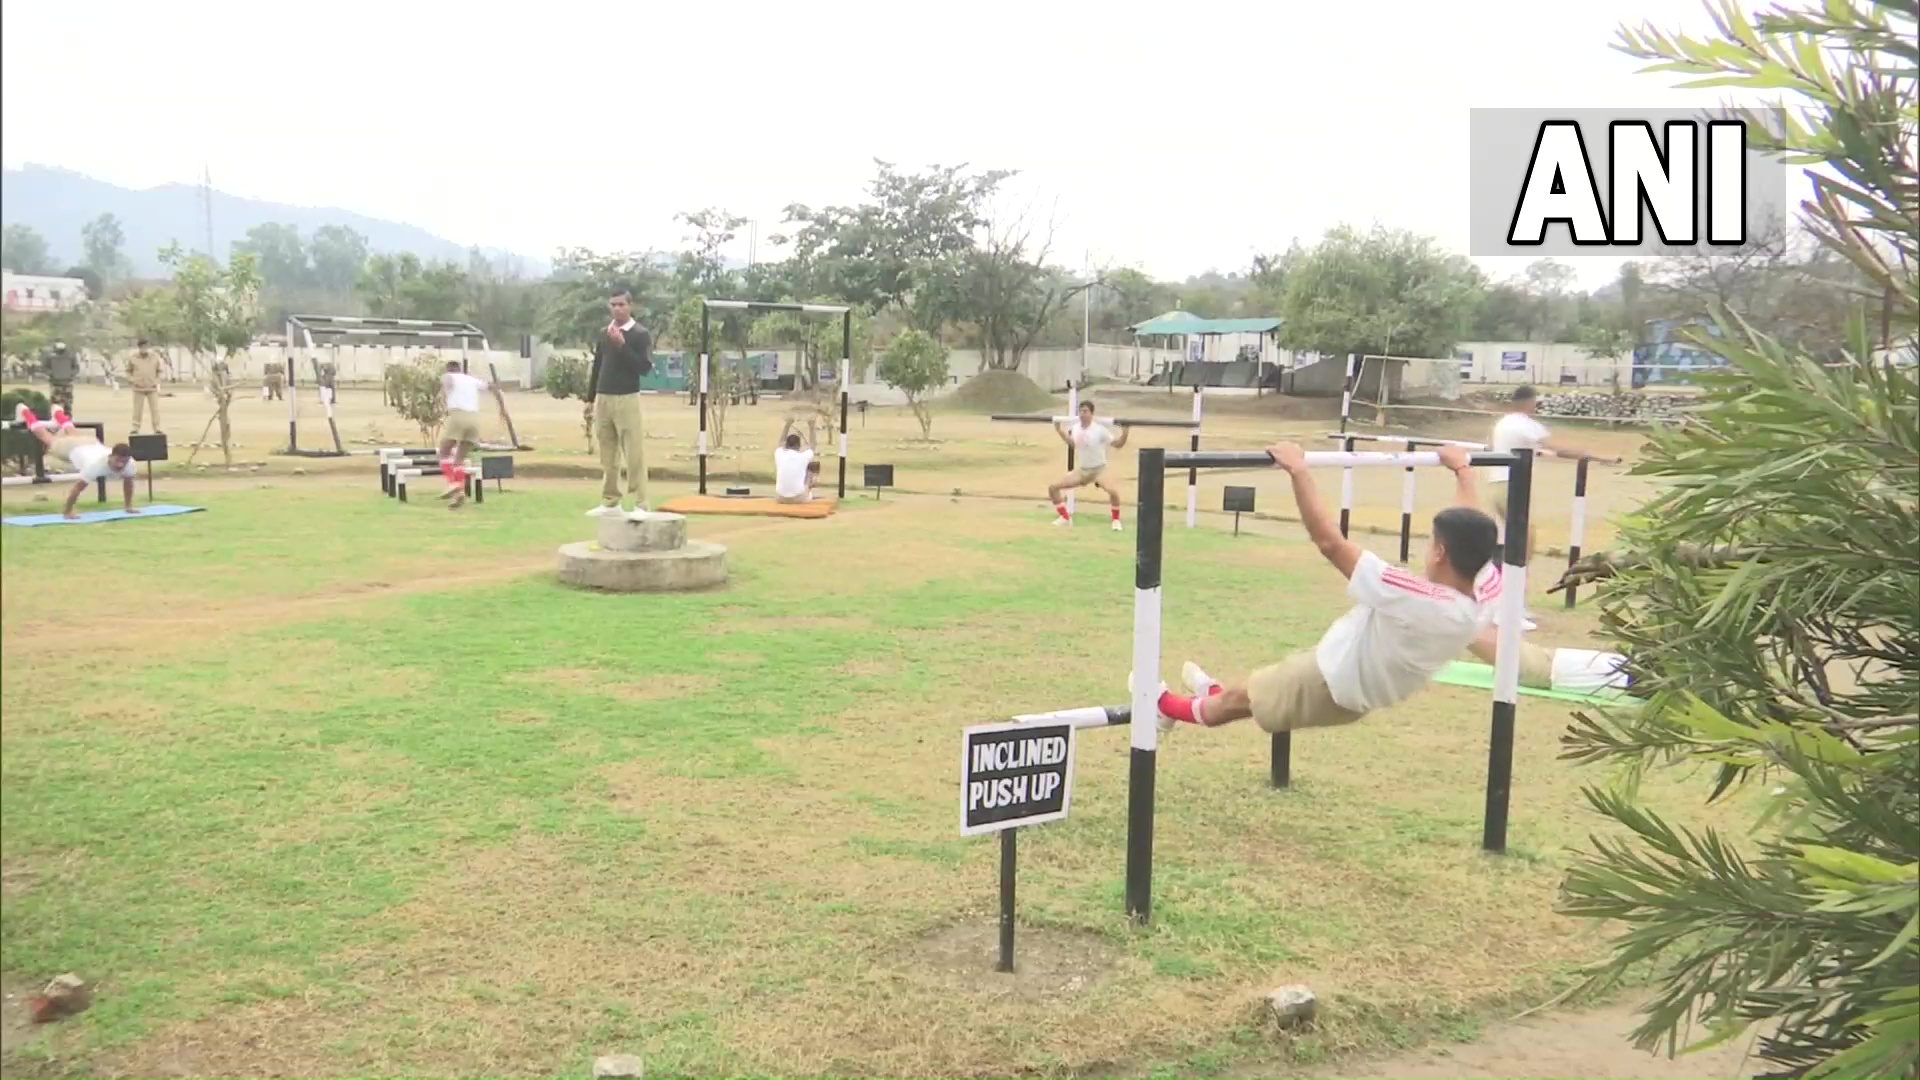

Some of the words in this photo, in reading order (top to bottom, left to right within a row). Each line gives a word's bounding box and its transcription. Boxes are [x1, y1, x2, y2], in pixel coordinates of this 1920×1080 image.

[971, 736, 1067, 773] INCLINED
[969, 775, 1028, 811] PUSH
[1031, 771, 1061, 801] UP
